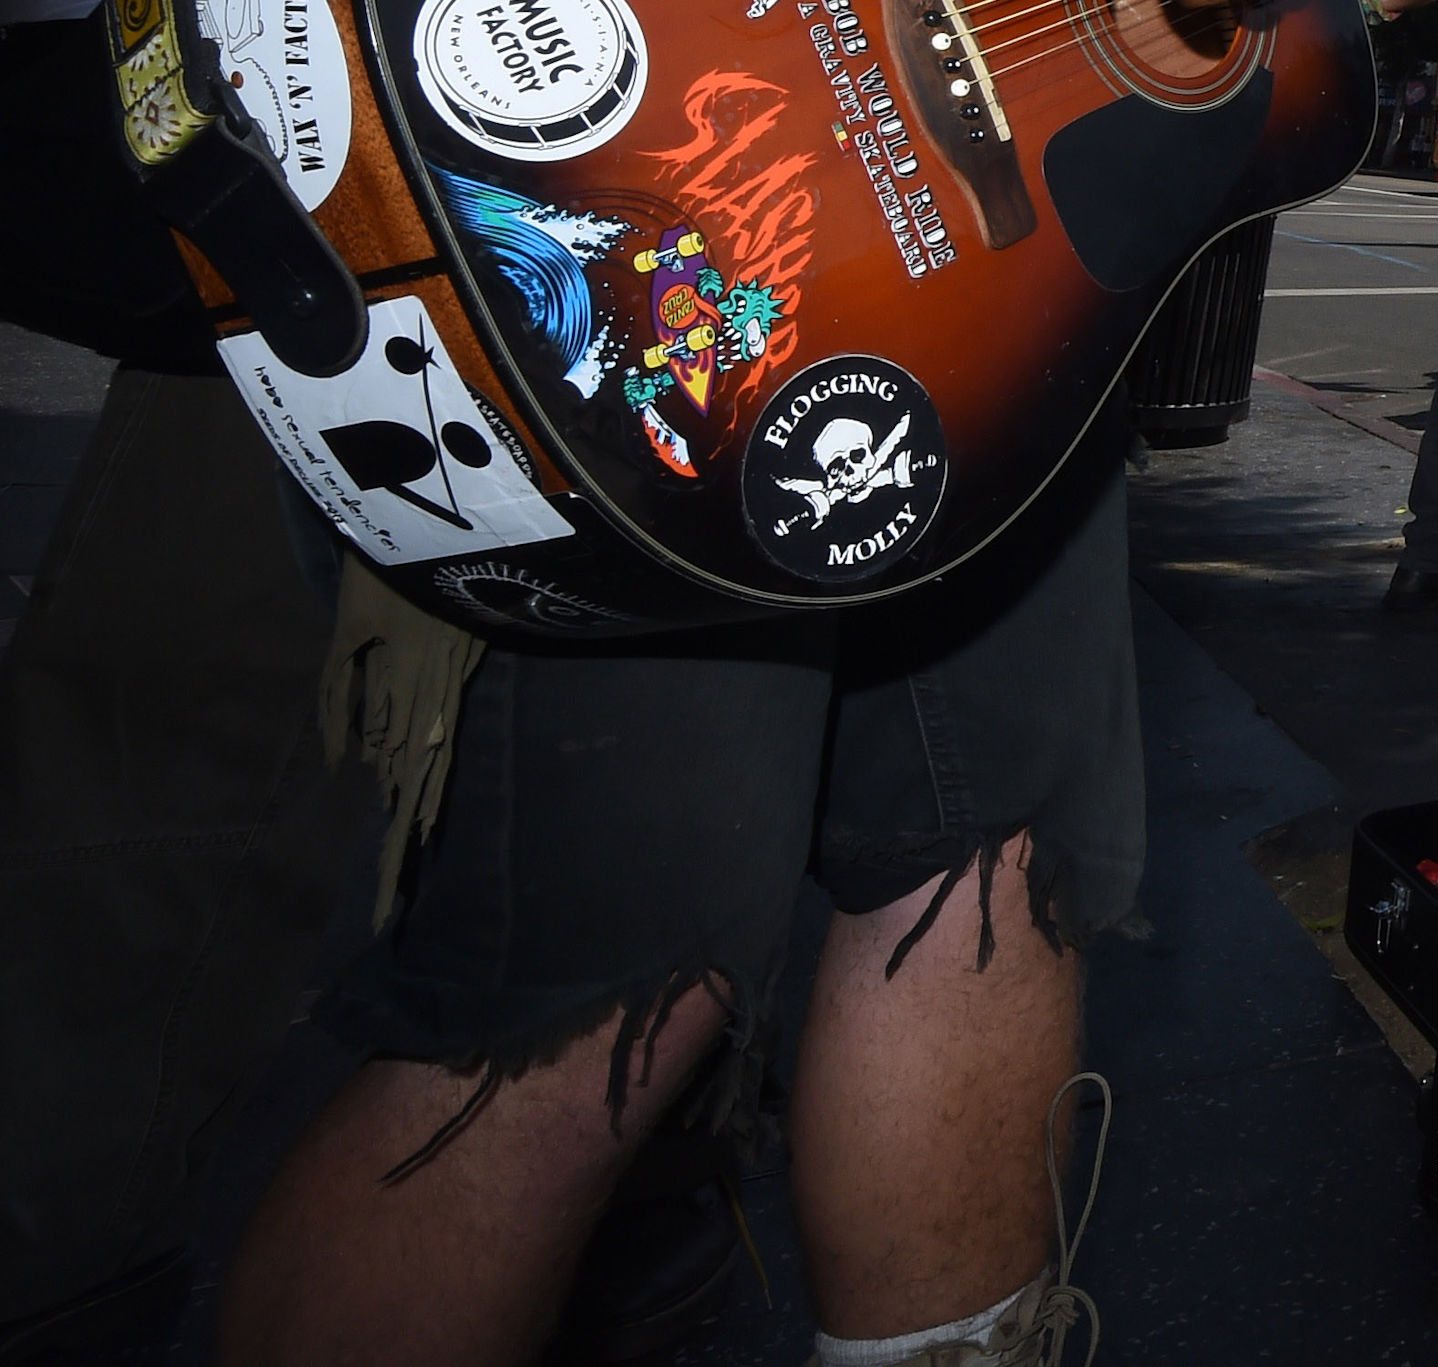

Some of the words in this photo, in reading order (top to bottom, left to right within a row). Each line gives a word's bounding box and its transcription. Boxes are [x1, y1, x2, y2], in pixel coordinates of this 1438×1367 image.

[450, 14, 464, 48] NEW
[476, 5, 546, 94] FACTORY
[453, 54, 511, 110] ORLEANS
[293, 119, 326, 173] WAX
[797, 1, 816, 19] A
[809, 22, 866, 126] GRAVITY
[853, 130, 930, 280] SKATEBOARD
[857, 62, 919, 179] WOULD
[905, 184, 958, 271] RIDE
[662, 286, 688, 309] CRUZ
[282, 414, 325, 465] sexual
[764, 373, 899, 450] FLOGGING
[827, 502, 918, 566] MOLLY
